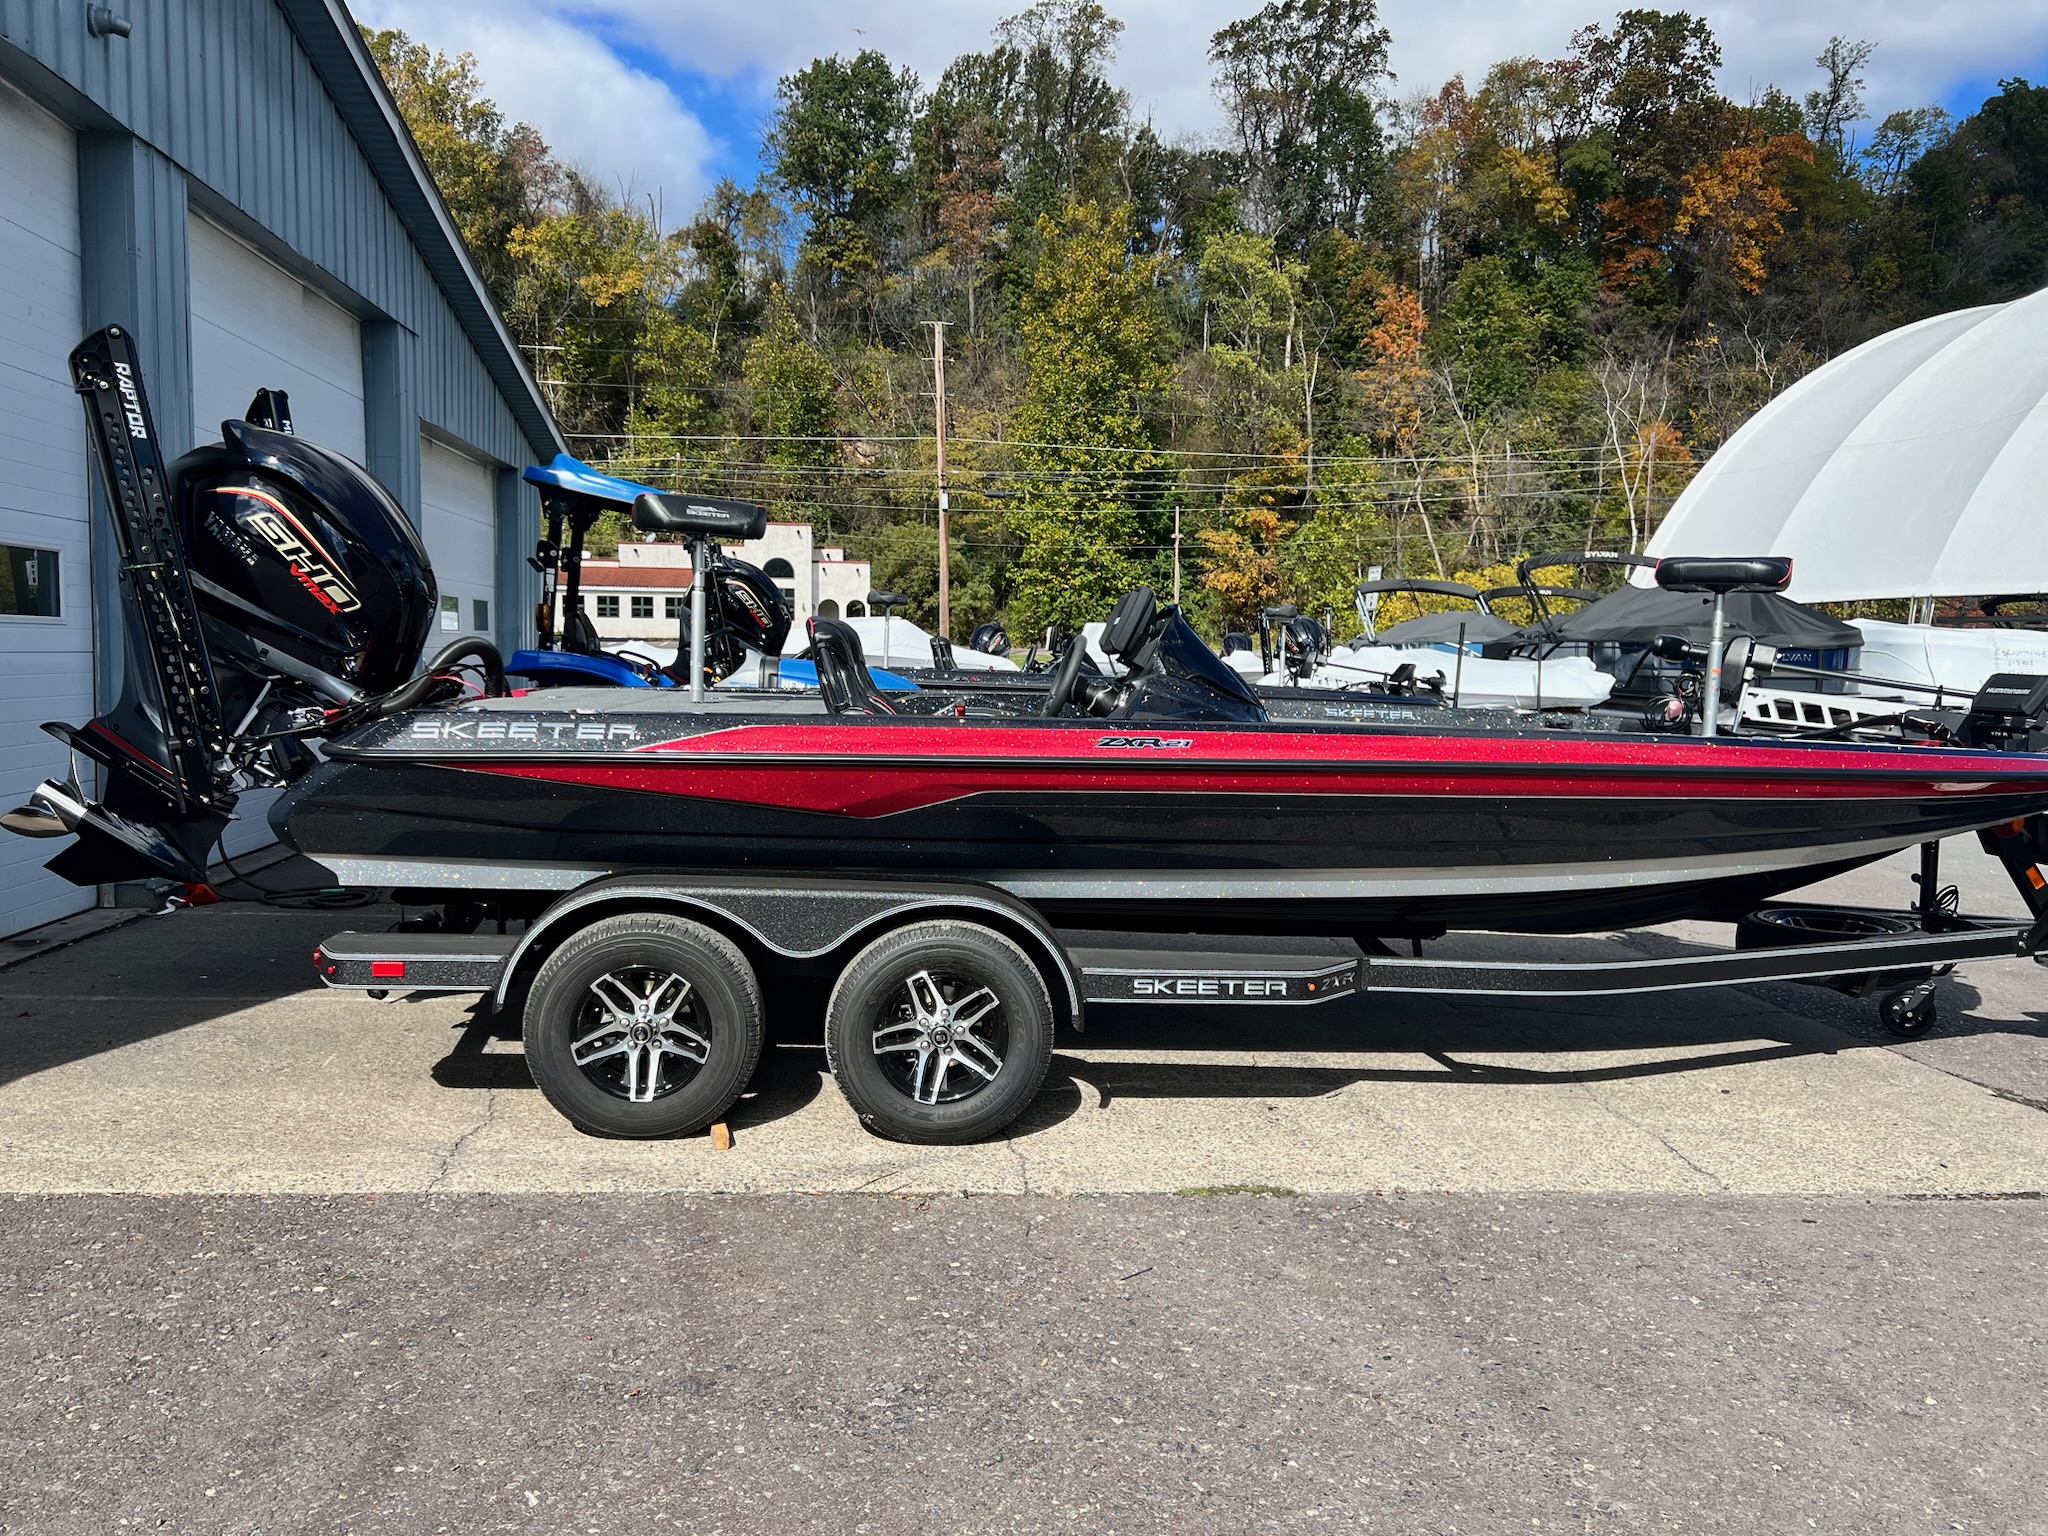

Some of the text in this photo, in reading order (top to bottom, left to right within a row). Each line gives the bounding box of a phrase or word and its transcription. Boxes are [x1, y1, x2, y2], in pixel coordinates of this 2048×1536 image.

[113, 361, 148, 439] RAPTOR
[245, 511, 362, 613] SHO
[1584, 551, 1619, 559] SYLVAN
[734, 589, 773, 628] SHO
[1781, 653, 1812, 662] LVAN
[1325, 708, 1416, 721] SKEETER
[410, 721, 639, 741] SKEETER
[1133, 978, 1288, 997] SKEETER
[1320, 971, 1356, 991] ZXR
